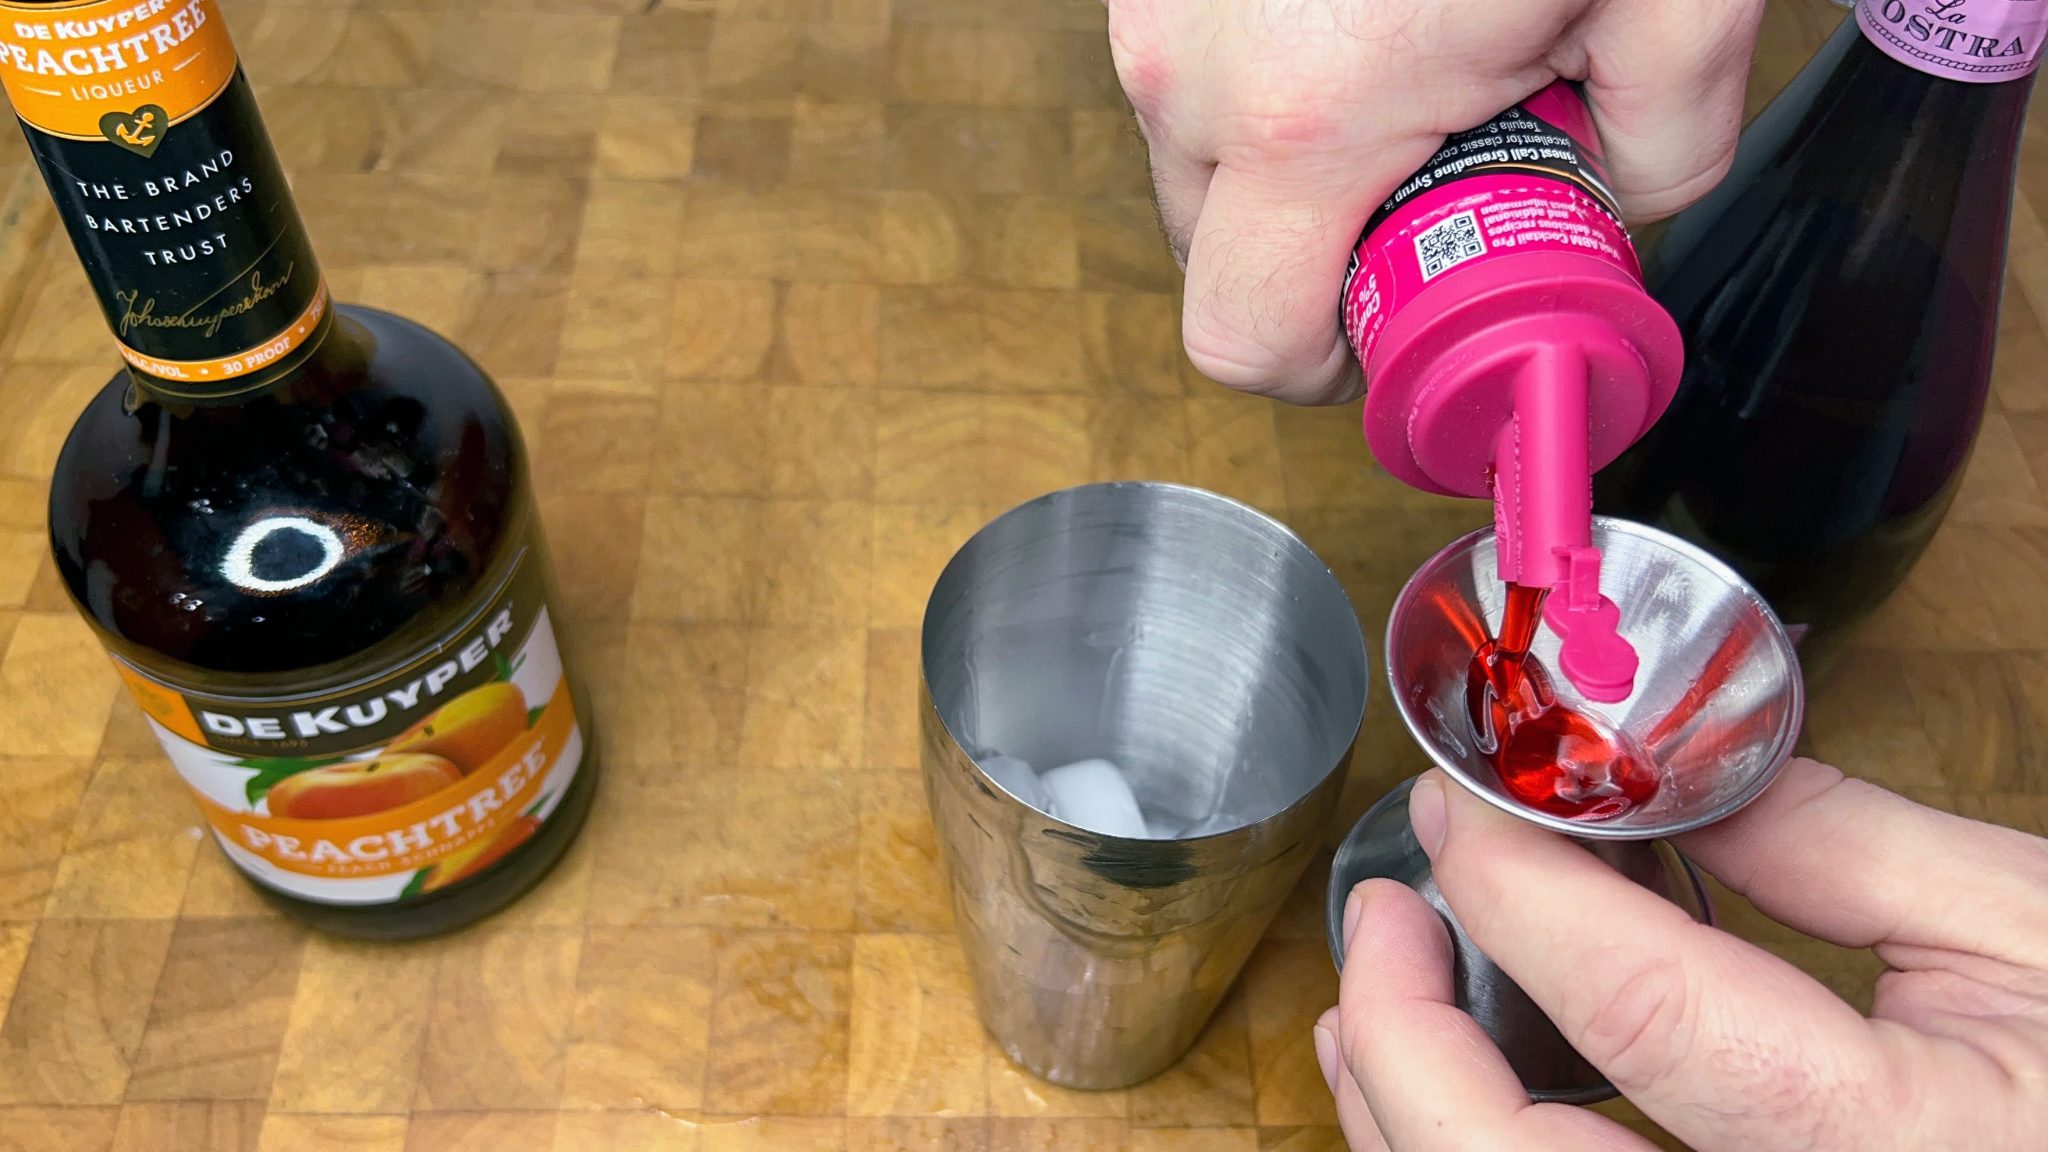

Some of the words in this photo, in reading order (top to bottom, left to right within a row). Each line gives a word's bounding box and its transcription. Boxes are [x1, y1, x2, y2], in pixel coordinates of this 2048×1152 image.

[14, 22, 53, 40] DE
[54, 0, 167, 40] KUYPER
[71, 70, 165, 101] LIQUEUR
[1499, 119, 1542, 133] Tequila
[1460, 136, 1504, 153] classic
[1505, 134, 1523, 146] for
[1510, 146, 1540, 161] Call
[1538, 148, 1578, 165] Finest
[1433, 148, 1509, 178] Grenadine
[76, 181, 129, 200] THE
[145, 149, 234, 197] BRAND
[1394, 173, 1434, 203] Syrup
[85, 177, 253, 234] BARTENDERS
[1383, 199, 1395, 211] is
[1546, 208, 1569, 219] and
[1483, 206, 1546, 229] additional
[1487, 220, 1537, 237] recipes
[1537, 219, 1590, 236] delicious
[1491, 234, 1516, 248] Pro
[1515, 231, 1569, 246] Cocktail
[1569, 234, 1599, 250] ABM
[145, 233, 228, 266] TRUST
[222, 361, 243, 376] 30
[246, 336, 292, 368] PROOF
[200, 708, 288, 741] DE
[292, 607, 514, 739] KUYPER
[240, 743, 546, 866] PEACHTREE
